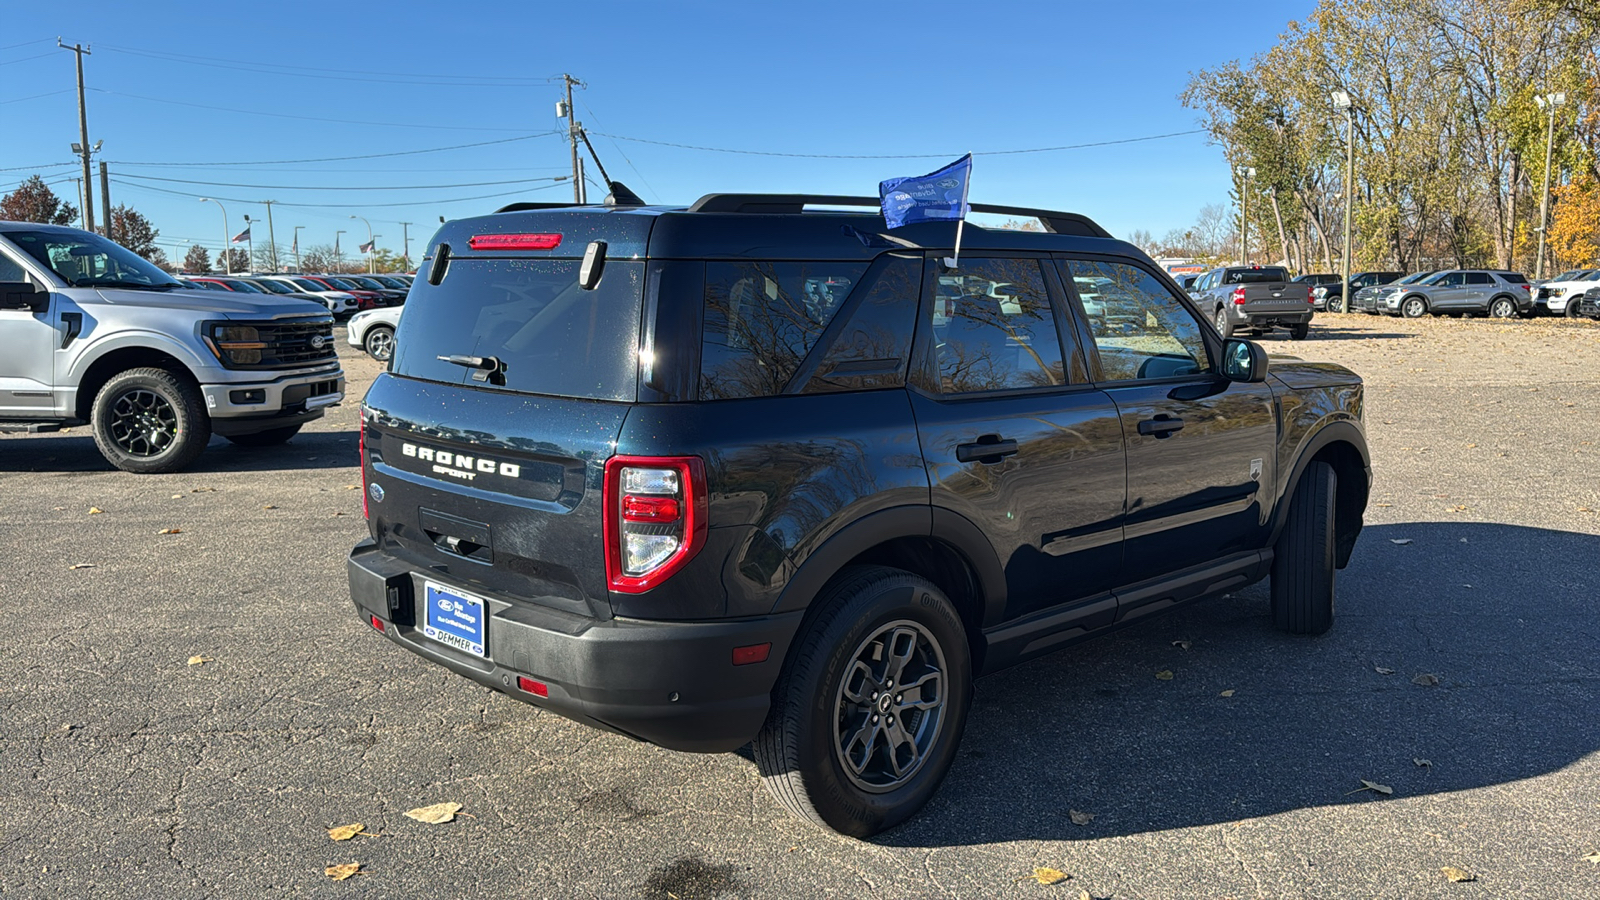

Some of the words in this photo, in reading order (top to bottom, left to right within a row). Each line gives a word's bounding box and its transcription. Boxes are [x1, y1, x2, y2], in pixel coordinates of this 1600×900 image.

[402, 443, 520, 478] BRONCO
[432, 464, 477, 481] SPORT
[437, 630, 471, 652] DEMMER
